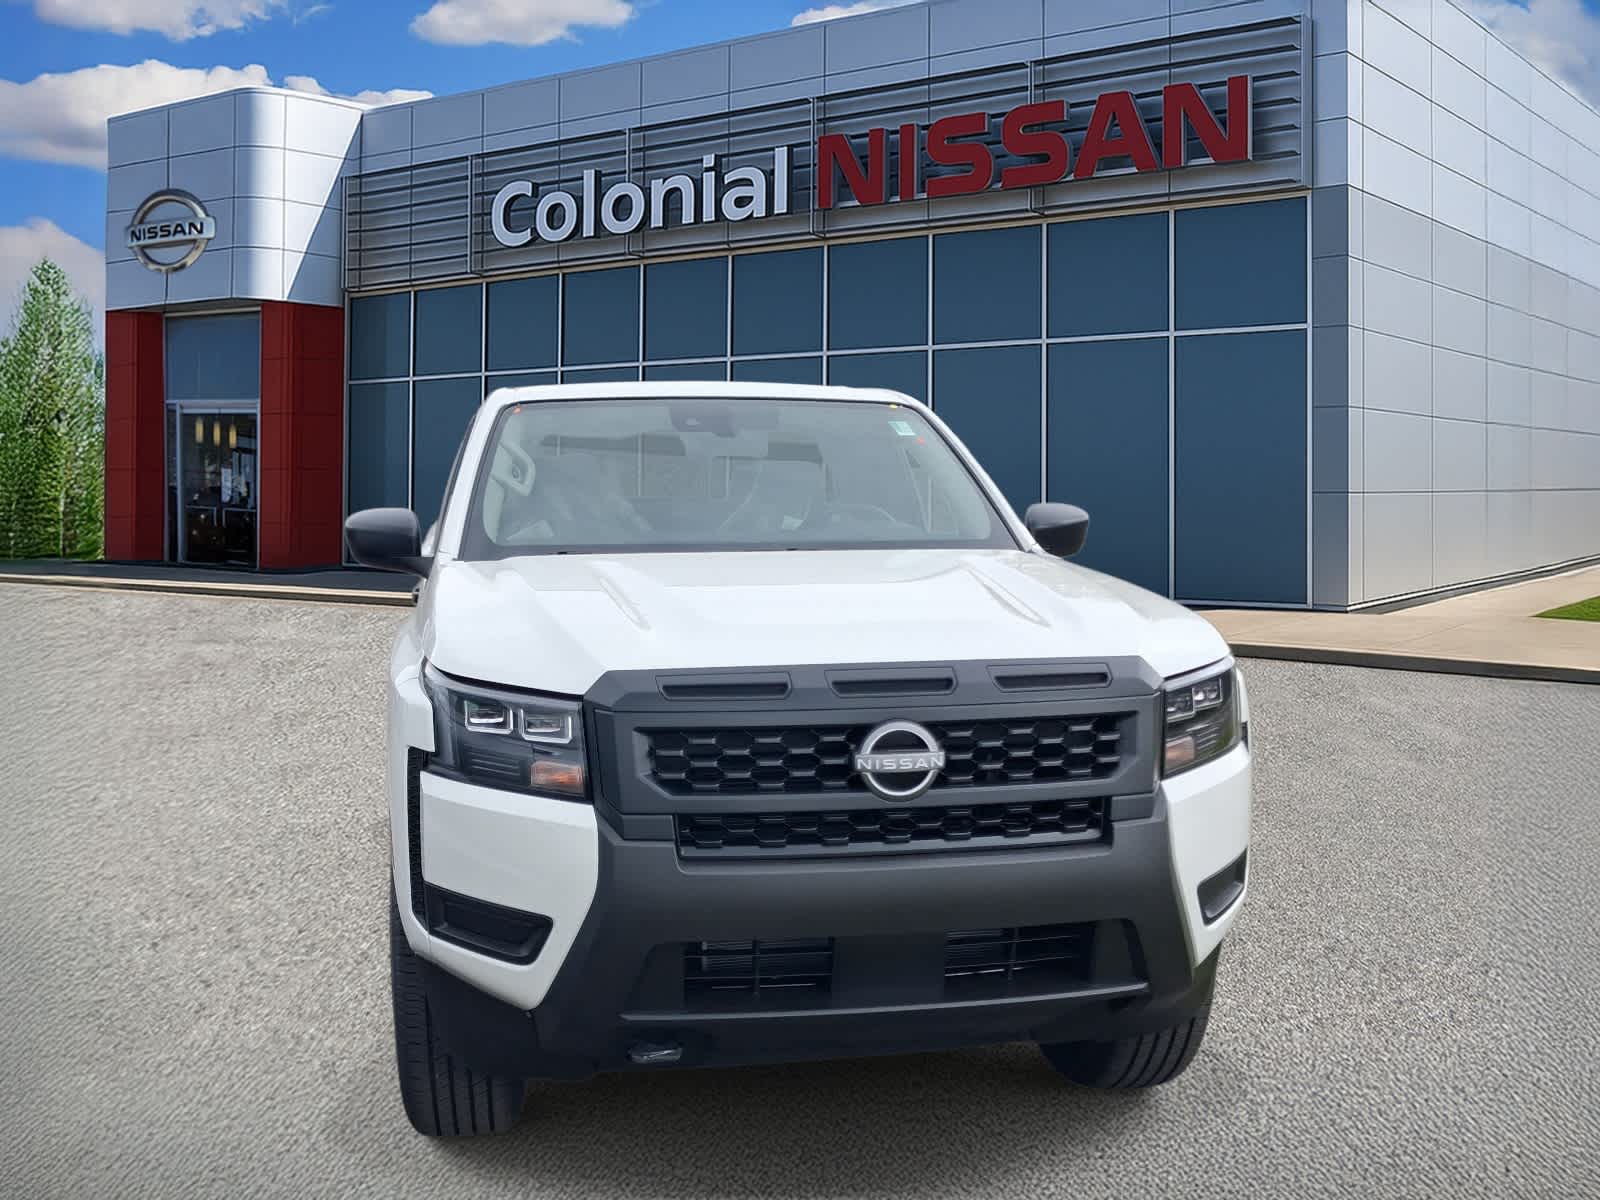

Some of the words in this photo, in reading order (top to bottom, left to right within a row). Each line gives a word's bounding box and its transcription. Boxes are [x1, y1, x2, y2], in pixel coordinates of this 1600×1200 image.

[491, 145, 791, 249] Colonial
[817, 75, 1254, 210] NISSAN
[130, 221, 204, 242] NISSAN
[857, 756, 943, 770] NISSAN
